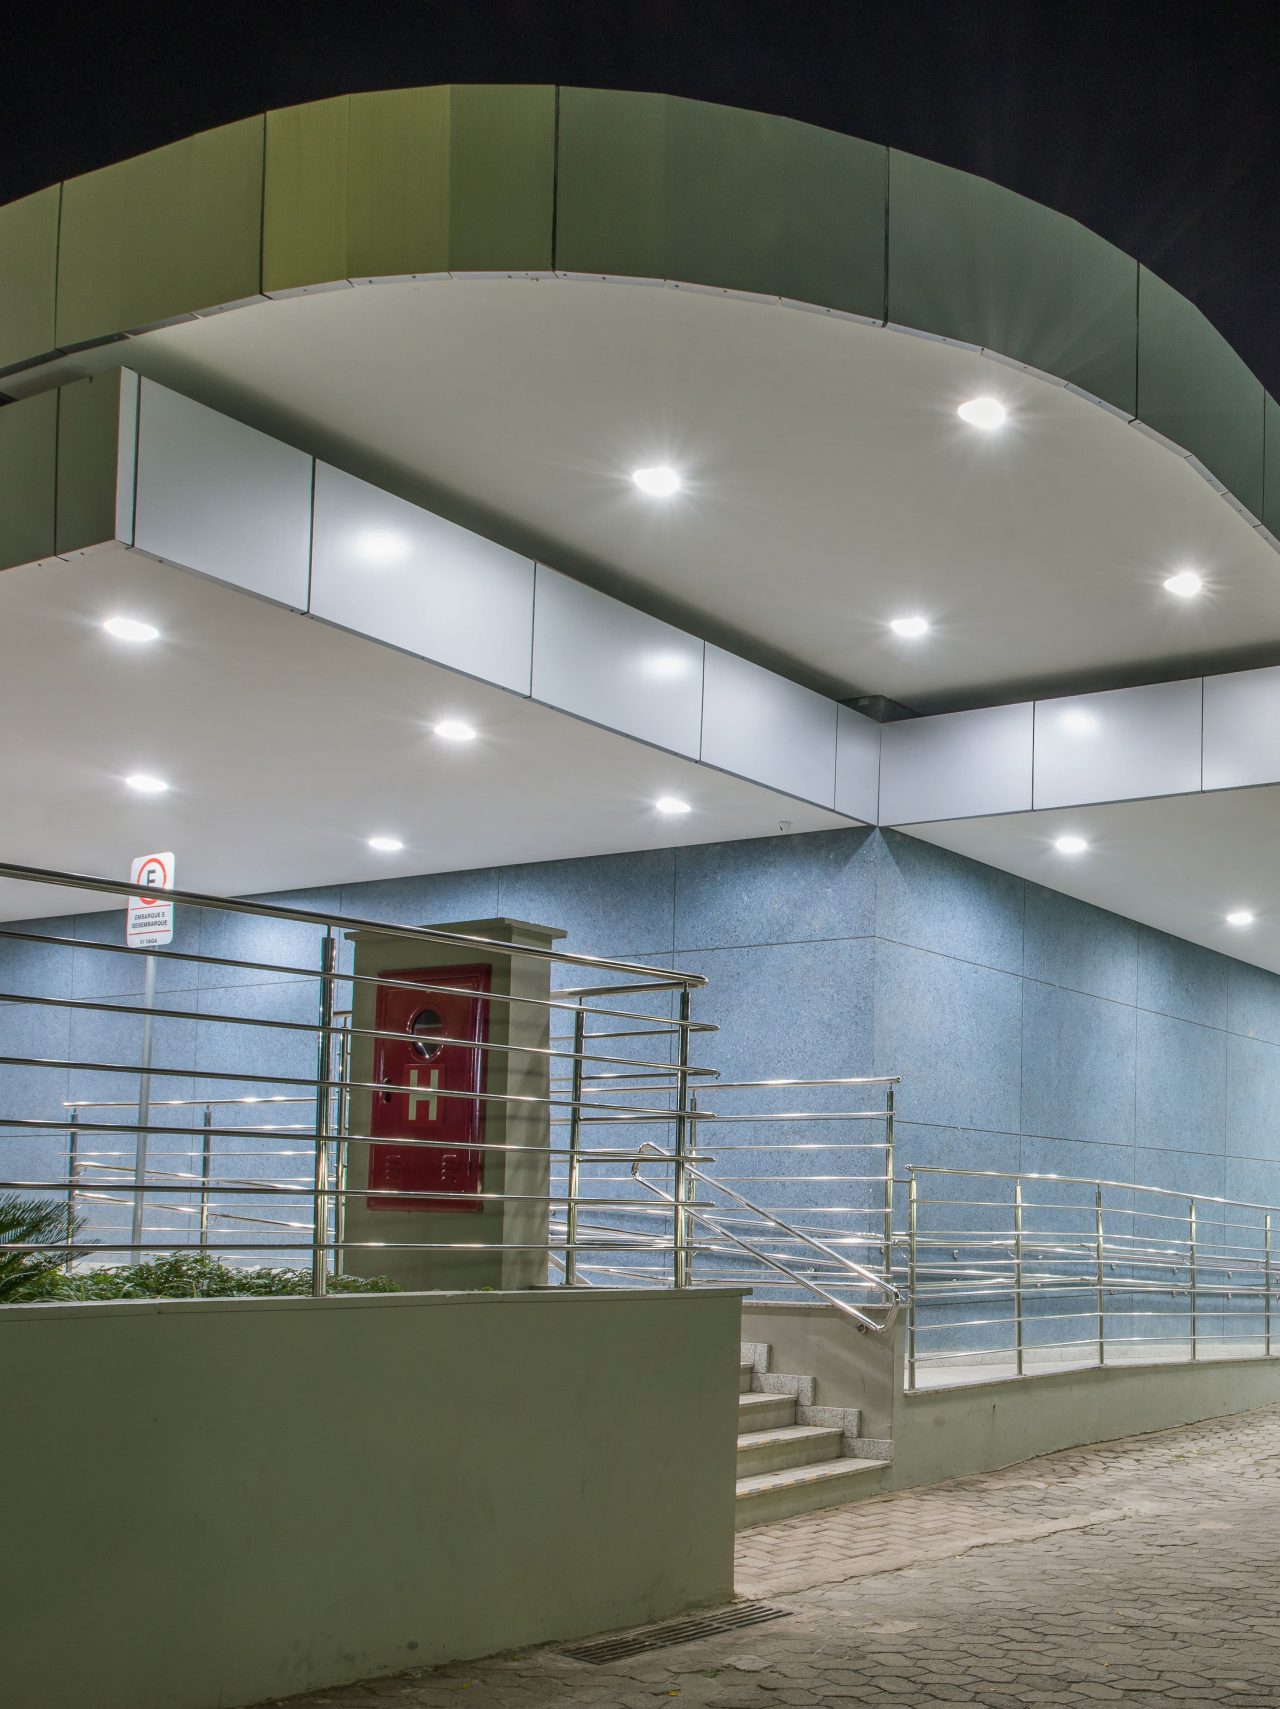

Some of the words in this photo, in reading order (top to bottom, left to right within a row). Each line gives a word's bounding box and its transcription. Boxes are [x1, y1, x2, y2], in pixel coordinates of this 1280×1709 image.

[134, 912, 161, 920] EMBARQUE
[132, 920, 168, 928] DESEMBARQUE
[408, 1070, 439, 1120] H
